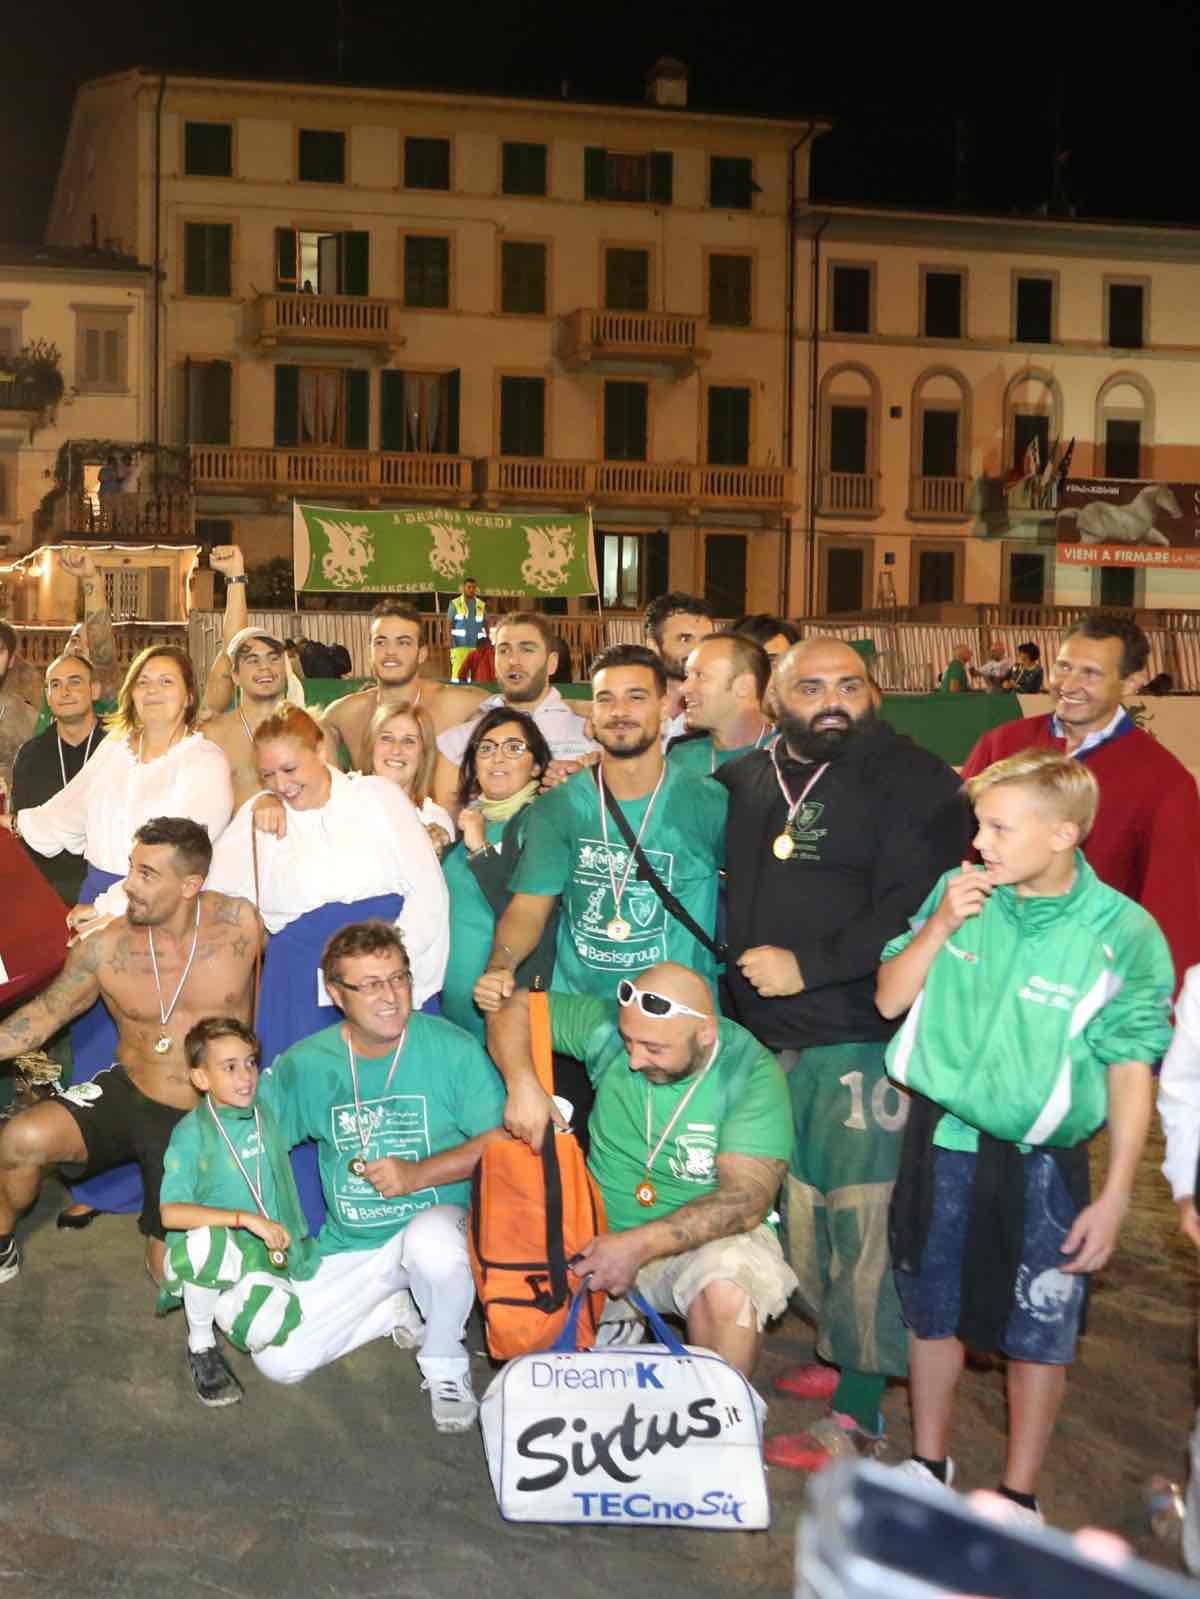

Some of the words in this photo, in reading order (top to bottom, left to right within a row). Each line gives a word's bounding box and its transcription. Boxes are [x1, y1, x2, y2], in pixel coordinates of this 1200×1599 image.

[1064, 547, 1098, 561] VIENI
[1102, 548, 1111, 561] A
[1114, 549, 1169, 562] FIRMARE
[589, 945, 660, 966] Basisgroup
[839, 1070, 912, 1132] 10
[531, 1361, 627, 1389] Dream
[636, 1362, 665, 1390] K
